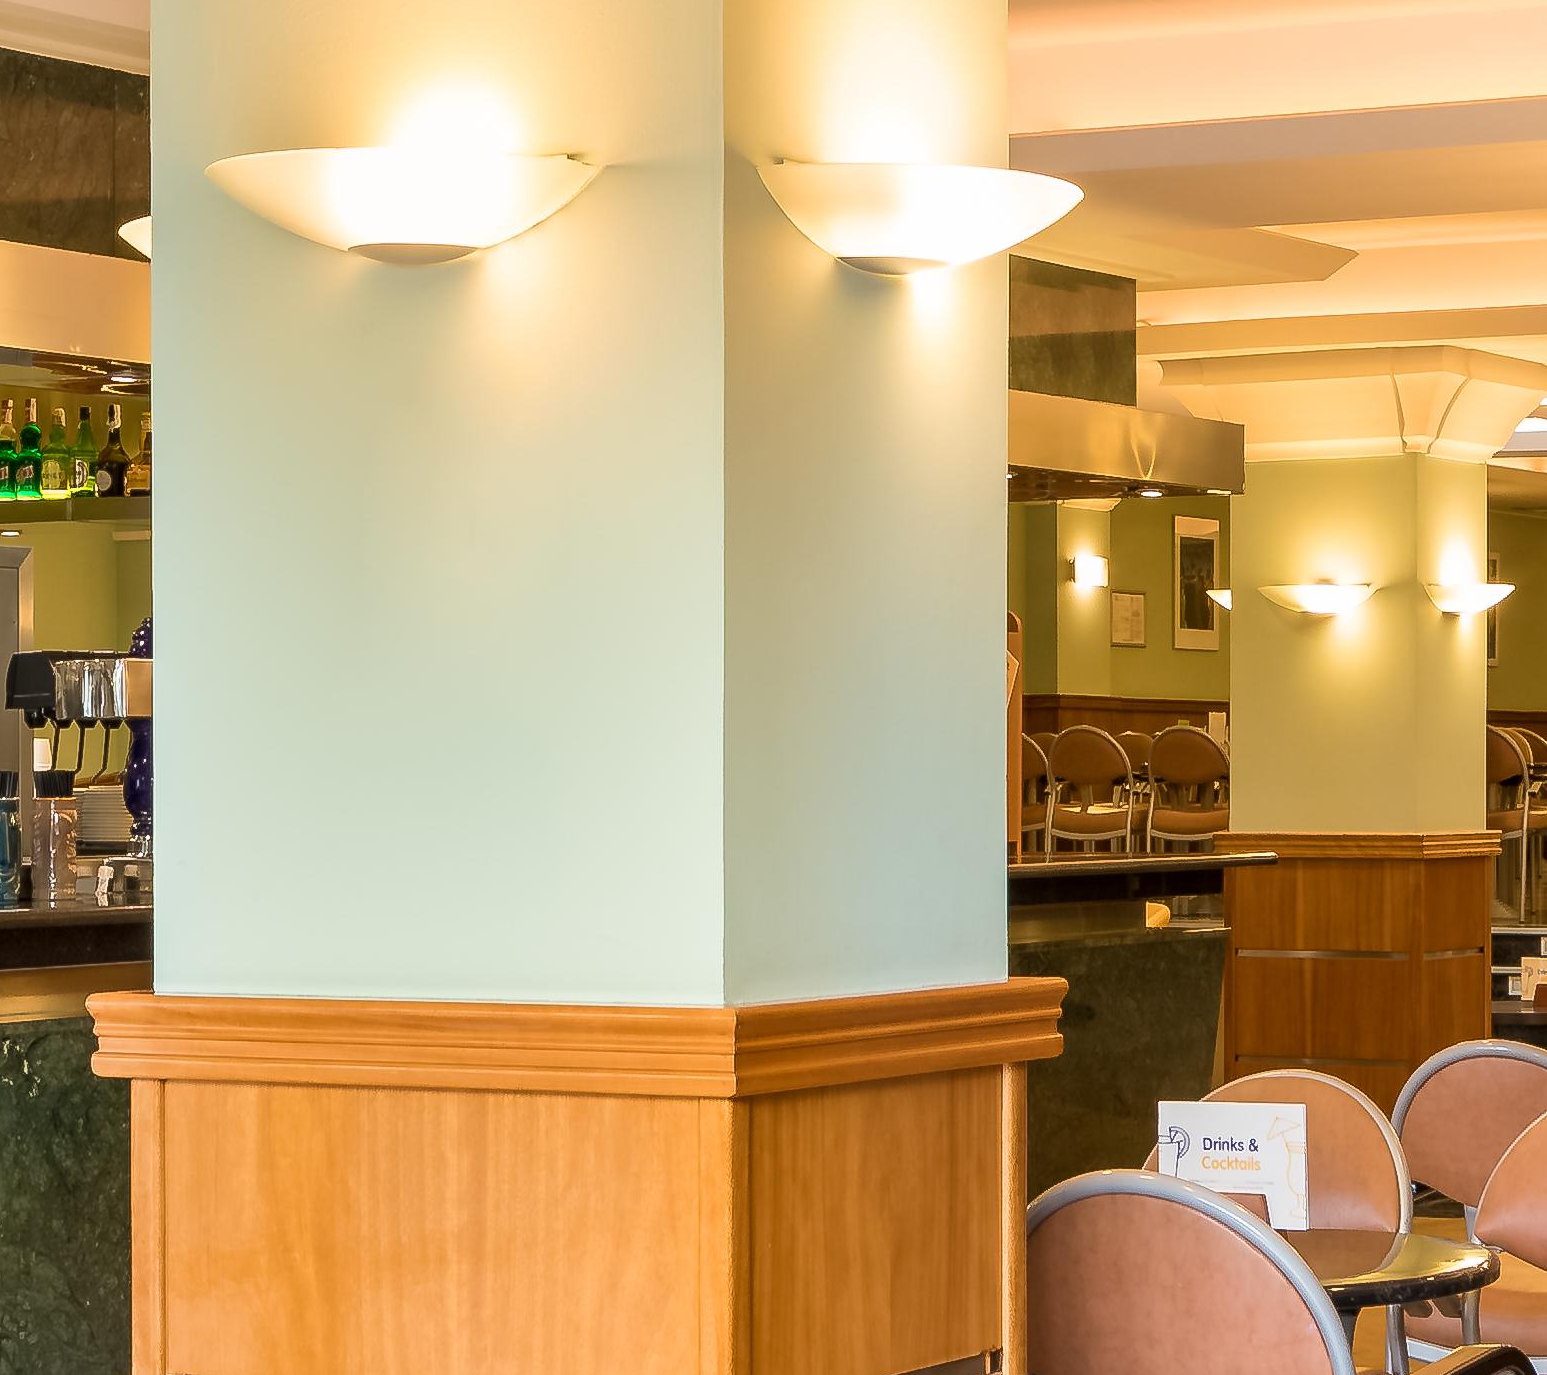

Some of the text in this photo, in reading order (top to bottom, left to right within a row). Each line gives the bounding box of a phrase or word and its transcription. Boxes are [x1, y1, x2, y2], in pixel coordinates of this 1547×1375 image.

[1202, 1136, 1259, 1152] Drinks &
[1201, 1155, 1262, 1171] Cocktails
